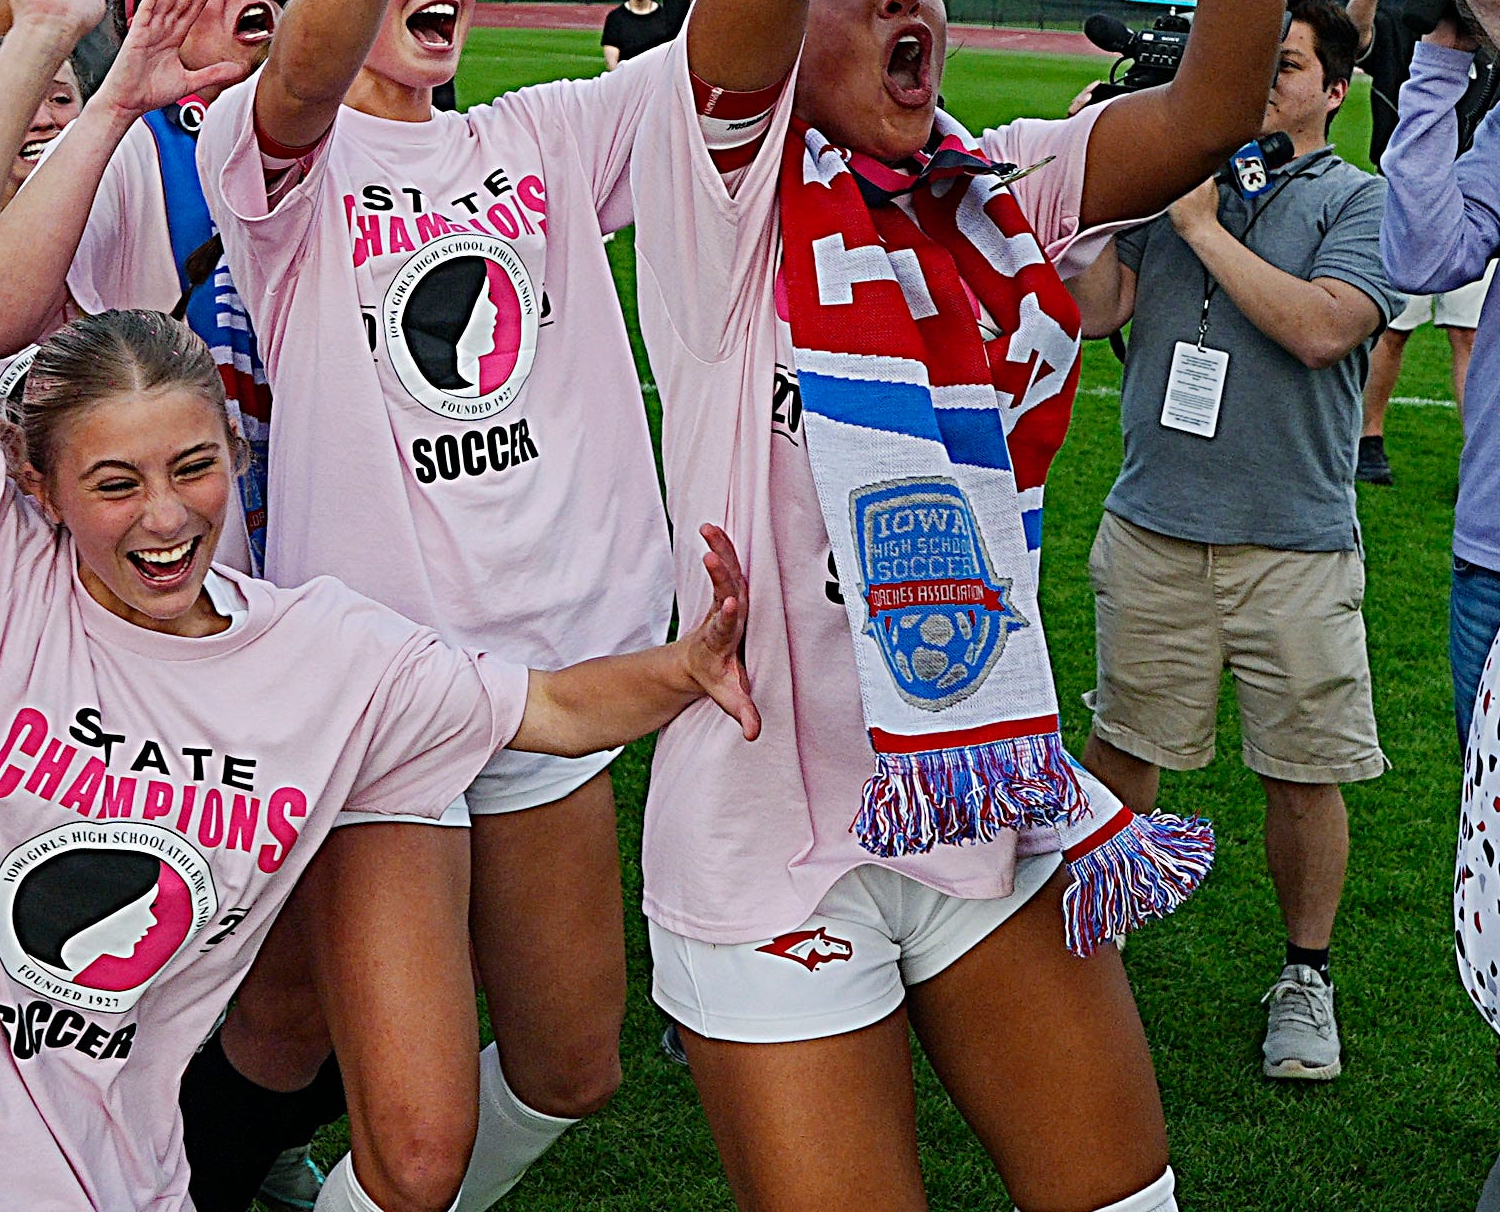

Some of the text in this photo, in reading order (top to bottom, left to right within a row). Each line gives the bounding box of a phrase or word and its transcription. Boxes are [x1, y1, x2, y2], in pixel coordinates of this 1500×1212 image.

[362, 168, 513, 214] STTE
[413, 250, 441, 274] HIGH
[441, 241, 486, 256] SCHOOL
[486, 245, 524, 280] ATHLETIC
[392, 272, 416, 307] GIRLS
[517, 279, 533, 316] UNION
[390, 310, 400, 339] IOWA
[440, 387, 513, 415] FOUNDED 1927
[411, 418, 540, 484] SOCCER
[877, 508, 968, 538] IOWA
[871, 538, 912, 559] HIGH
[877, 555, 975, 581] SOCCER
[69, 707, 257, 792] STATE
[4, 857, 30, 884] IOWA
[27, 834, 69, 861] GIRLS
[71, 831, 107, 844] HIGH
[112, 831, 167, 853] SCHOOL
[166, 846, 206, 895] ATHLETIC
[17, 964, 119, 1008] FOUNDED 1927
